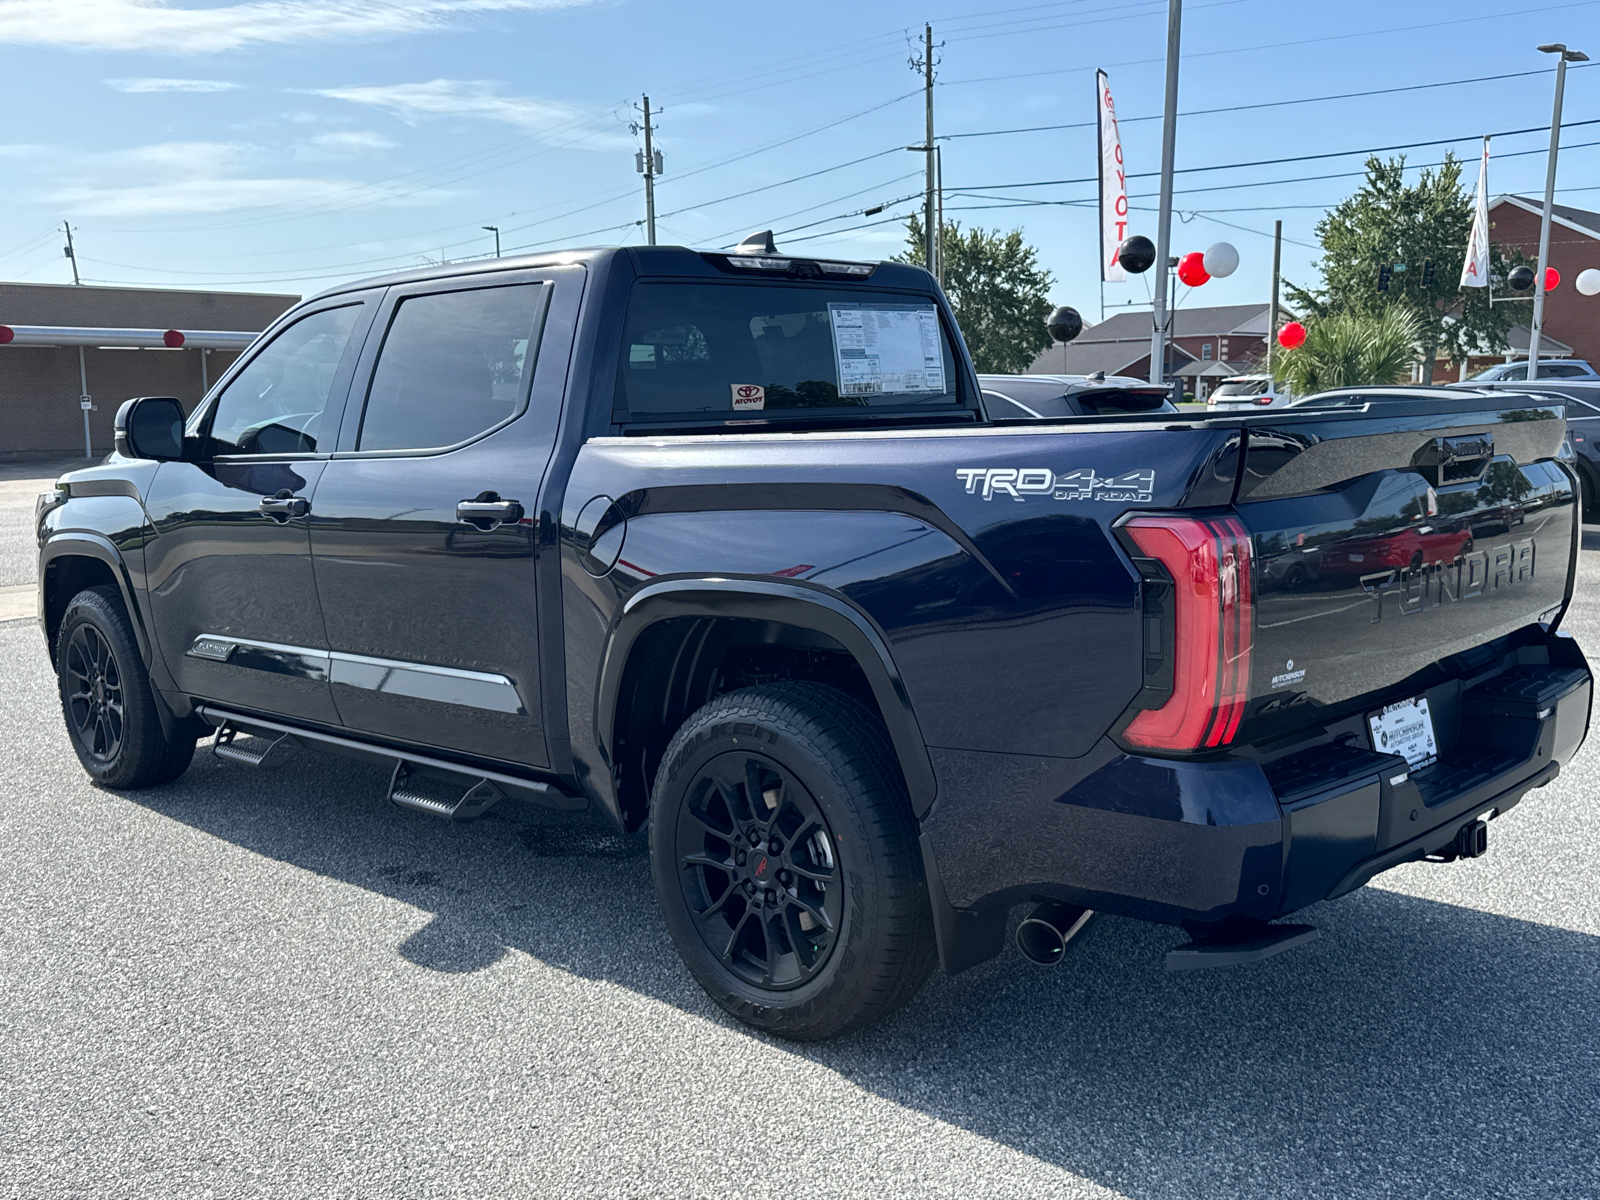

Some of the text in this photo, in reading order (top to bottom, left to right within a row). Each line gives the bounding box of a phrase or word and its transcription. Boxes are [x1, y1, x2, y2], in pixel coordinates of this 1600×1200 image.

[956, 468, 1055, 501] TRD
[1053, 490, 1152, 502] OFF ROAD
[1359, 537, 1536, 624] TUNDRA
[199, 642, 228, 653] PLATINUM
[1271, 669, 1306, 684] HUTCHINSON
